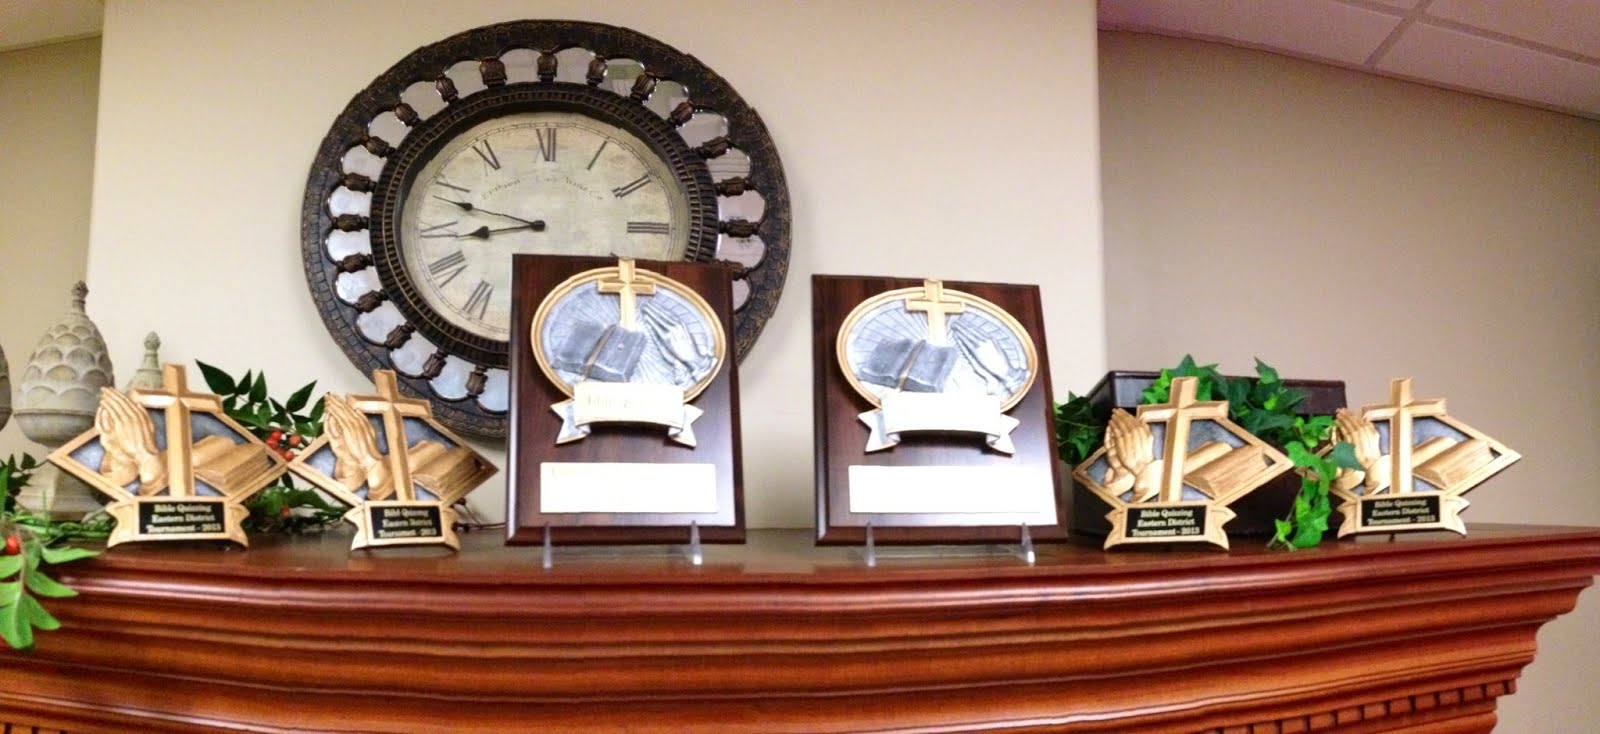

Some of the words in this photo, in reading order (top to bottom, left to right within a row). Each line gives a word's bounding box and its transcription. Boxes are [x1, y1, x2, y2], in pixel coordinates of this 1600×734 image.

[626, 221, 671, 235] III
[1374, 500, 1394, 509] Bible
[1140, 509, 1160, 518] Bible
[1161, 508, 1194, 519] Quizzing
[1371, 508, 1401, 518] Eastern
[1401, 507, 1431, 516] District
[151, 513, 185, 524] Eastern
[1137, 519, 1167, 528] Eastern
[1167, 517, 1196, 527] District
[202, 523, 222, 532] 2013
[1131, 528, 1177, 537] Tournament
[1181, 526, 1201, 536] 2013
